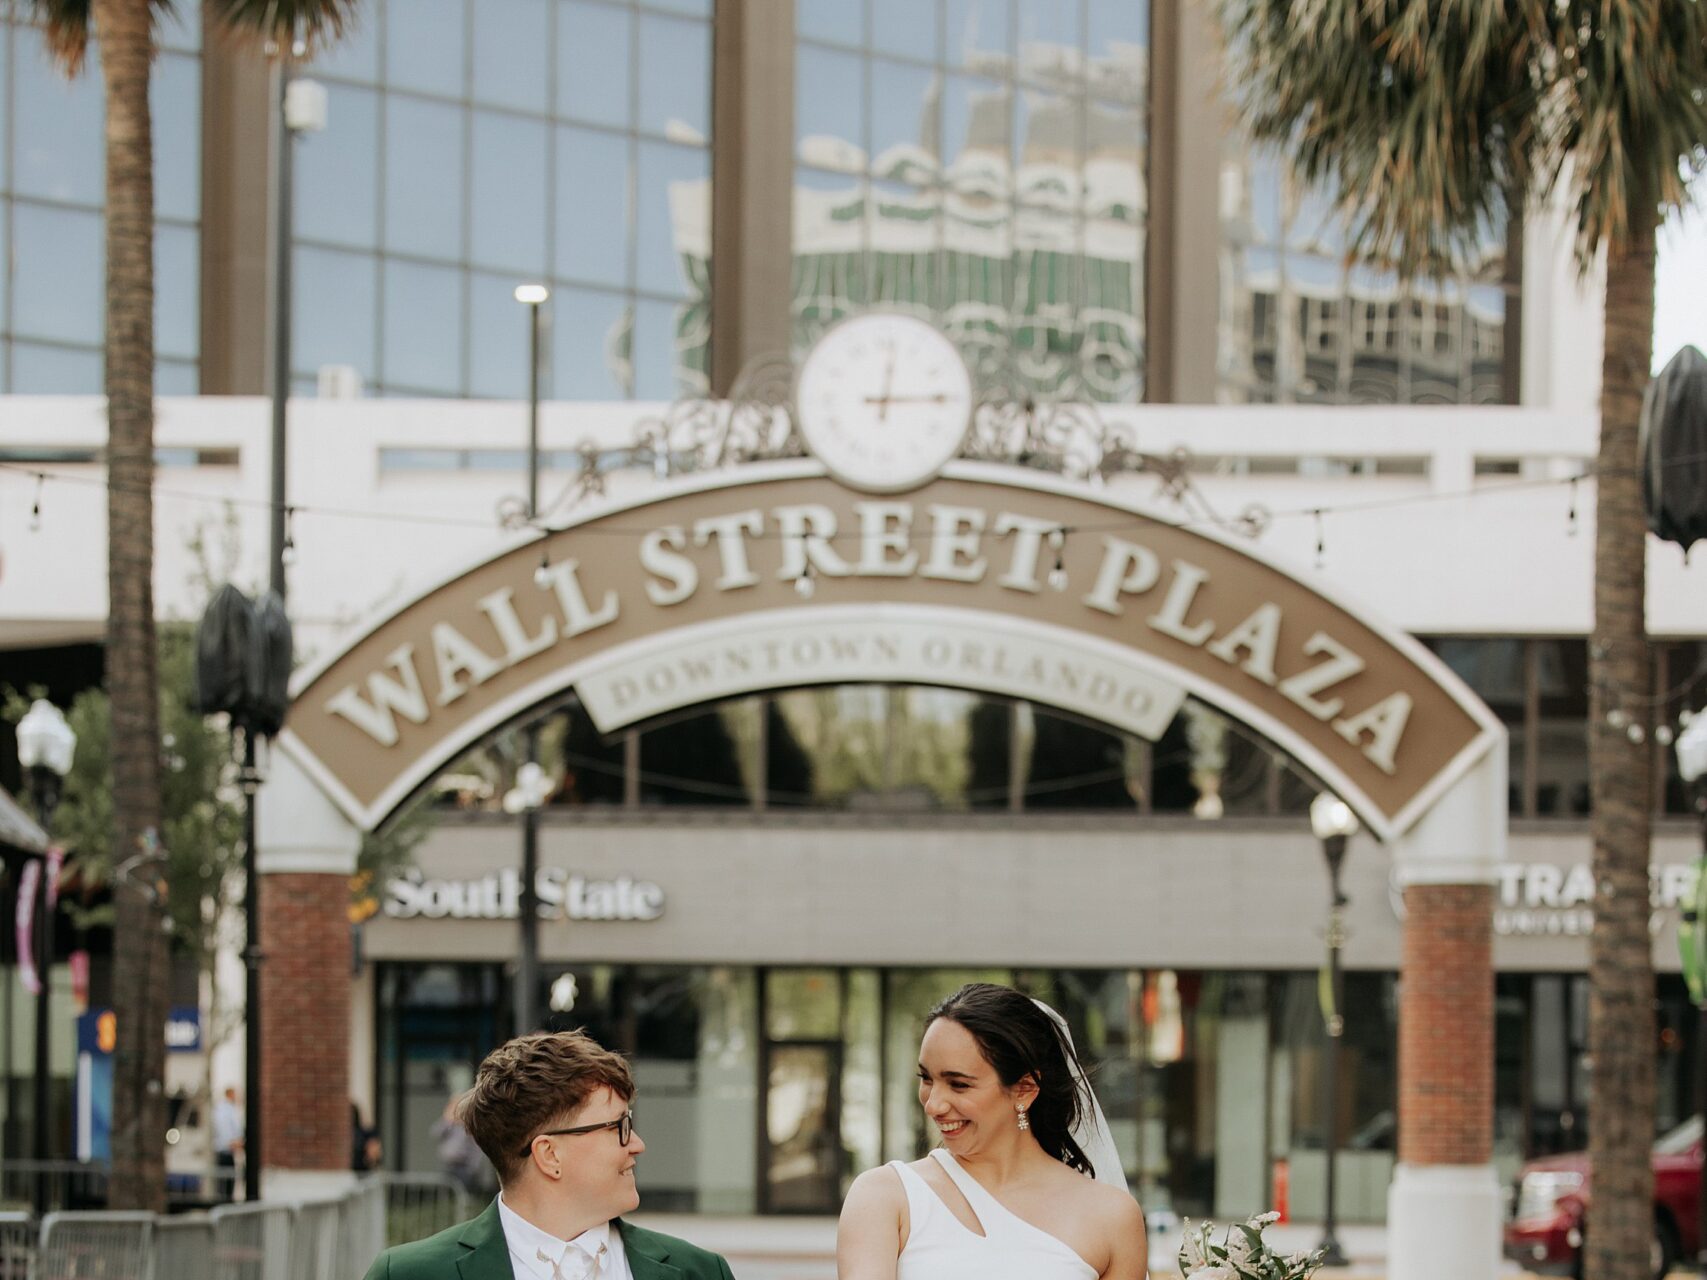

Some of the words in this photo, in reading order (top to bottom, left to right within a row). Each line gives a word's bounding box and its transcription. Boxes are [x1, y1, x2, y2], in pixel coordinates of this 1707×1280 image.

[328, 557, 620, 748] WALL
[639, 502, 1055, 606] STREET
[1084, 534, 1413, 774] PLAZA
[608, 633, 903, 708] DOWNTOWN
[921, 637, 1153, 718] ORLANDO
